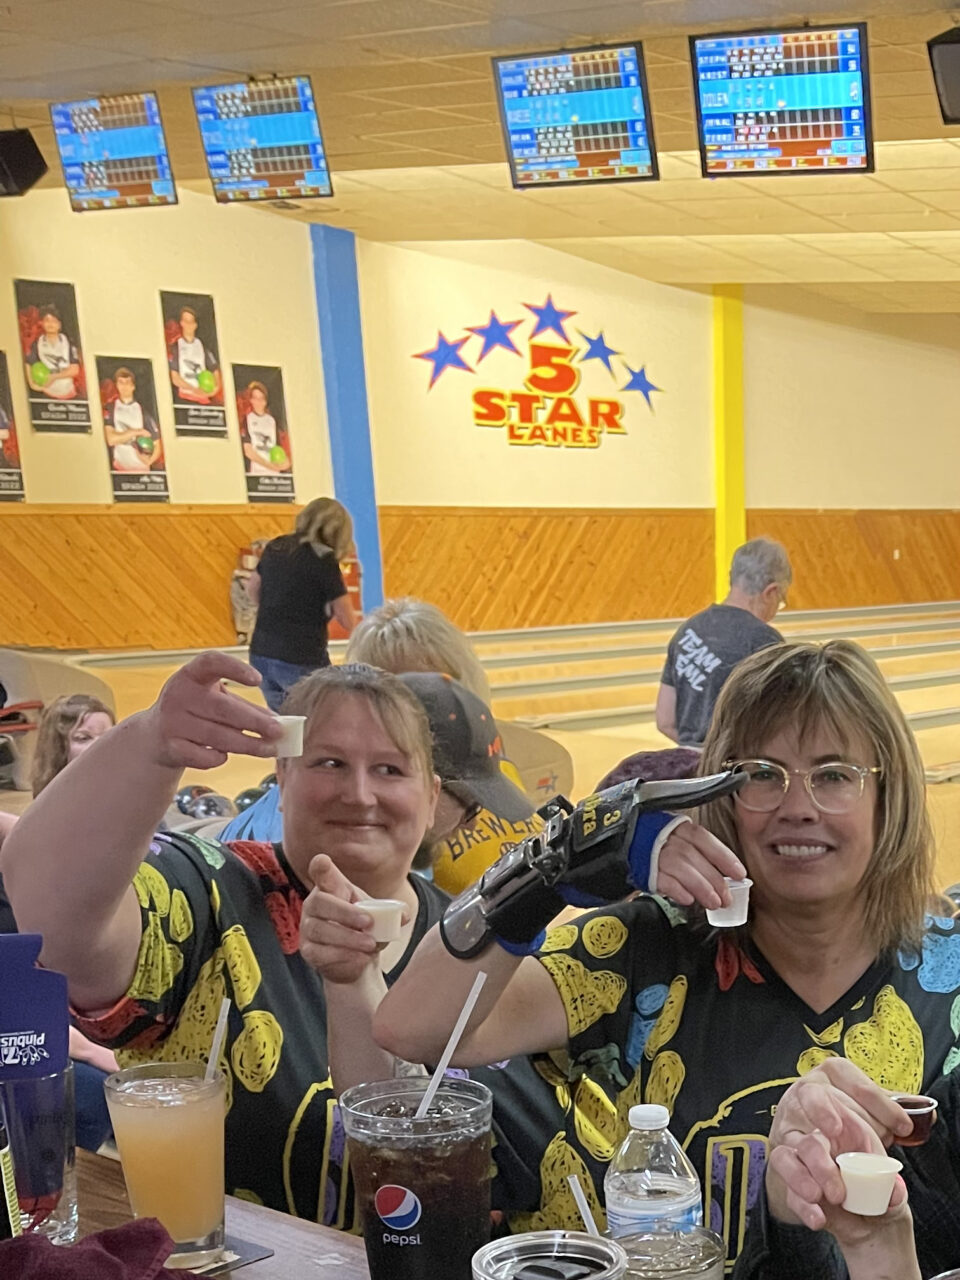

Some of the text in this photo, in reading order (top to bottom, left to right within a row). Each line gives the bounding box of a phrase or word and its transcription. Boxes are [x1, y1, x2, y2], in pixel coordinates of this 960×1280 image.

[525, 342, 580, 397] 5
[472, 389, 627, 434] STAR
[507, 422, 600, 446] LANES
[678, 628, 722, 673] TEAM
[382, 1232, 422, 1247] pepsi
